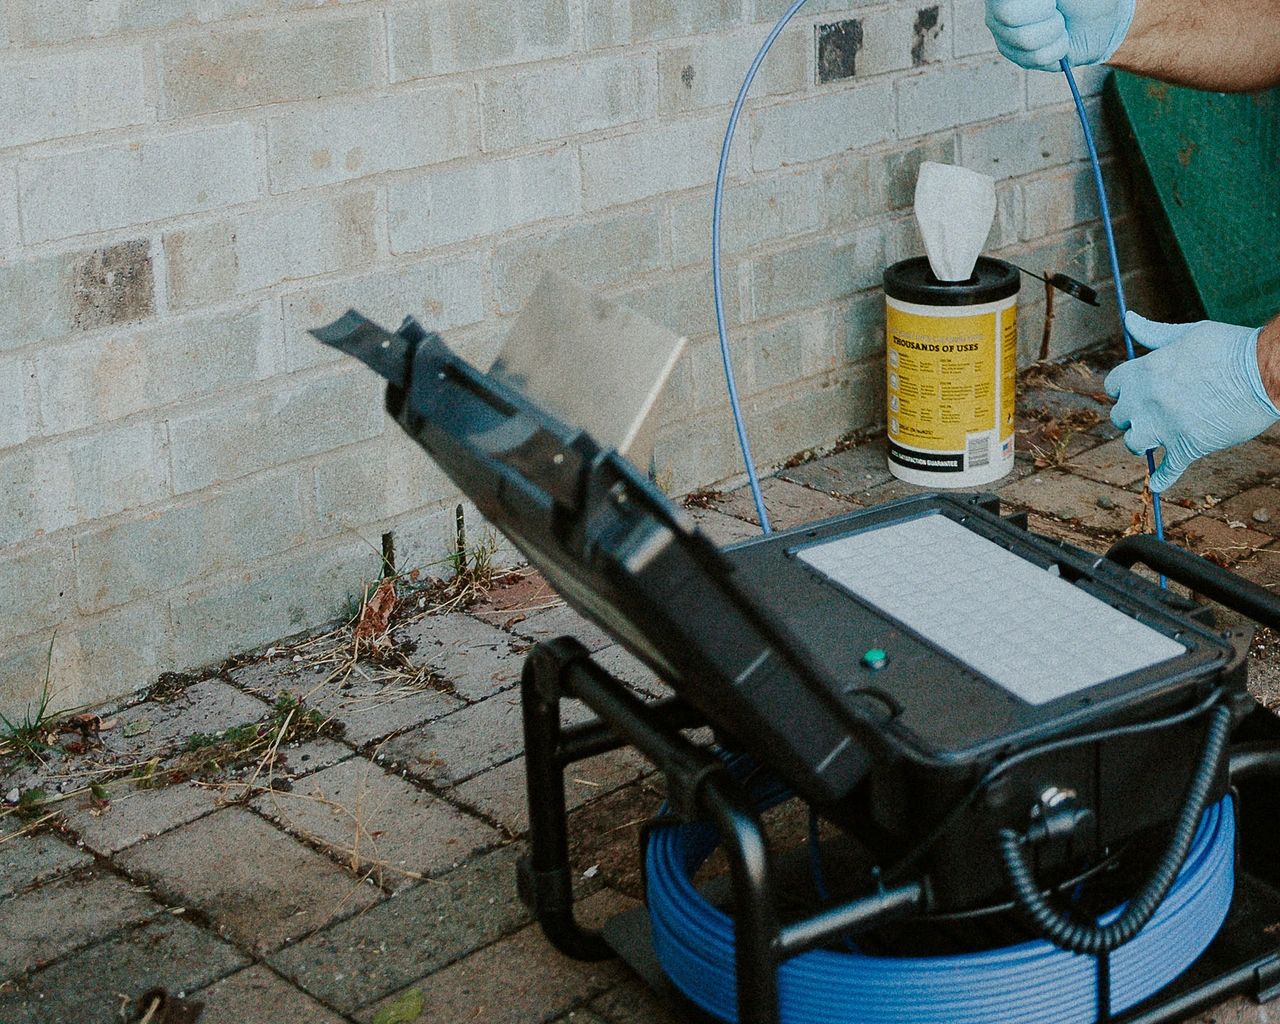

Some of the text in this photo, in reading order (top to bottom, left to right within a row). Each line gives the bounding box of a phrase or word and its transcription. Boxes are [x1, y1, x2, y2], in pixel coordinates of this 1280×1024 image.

[893, 336, 940, 352] THOUSANDS
[942, 345, 954, 353] OF
[956, 343, 979, 352] USES
